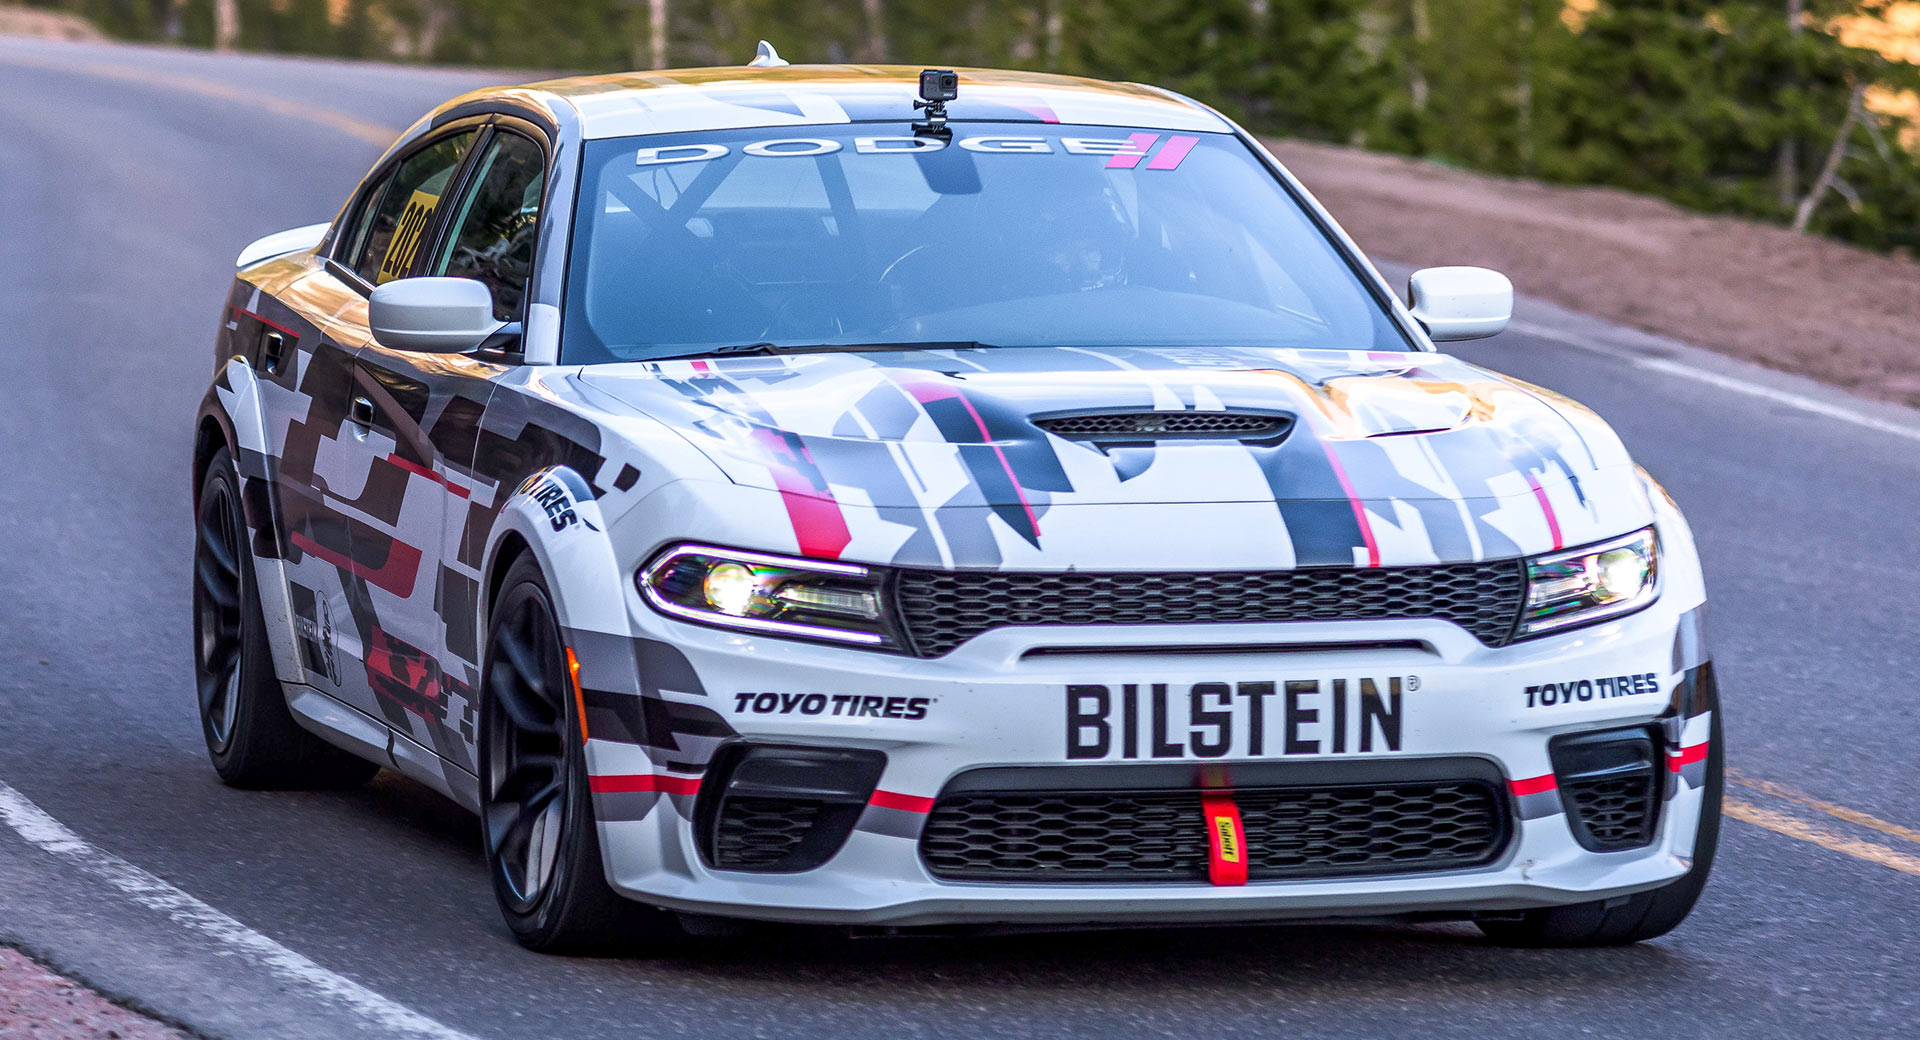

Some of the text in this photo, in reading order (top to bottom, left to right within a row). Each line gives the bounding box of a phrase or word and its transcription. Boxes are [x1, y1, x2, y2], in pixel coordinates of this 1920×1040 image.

[635, 137, 1147, 165] DODGE
[1524, 673, 1659, 706] TOYO TIRES
[735, 693, 930, 720] TOYO TIRES
[1066, 677, 1402, 759] BILSTEIN
